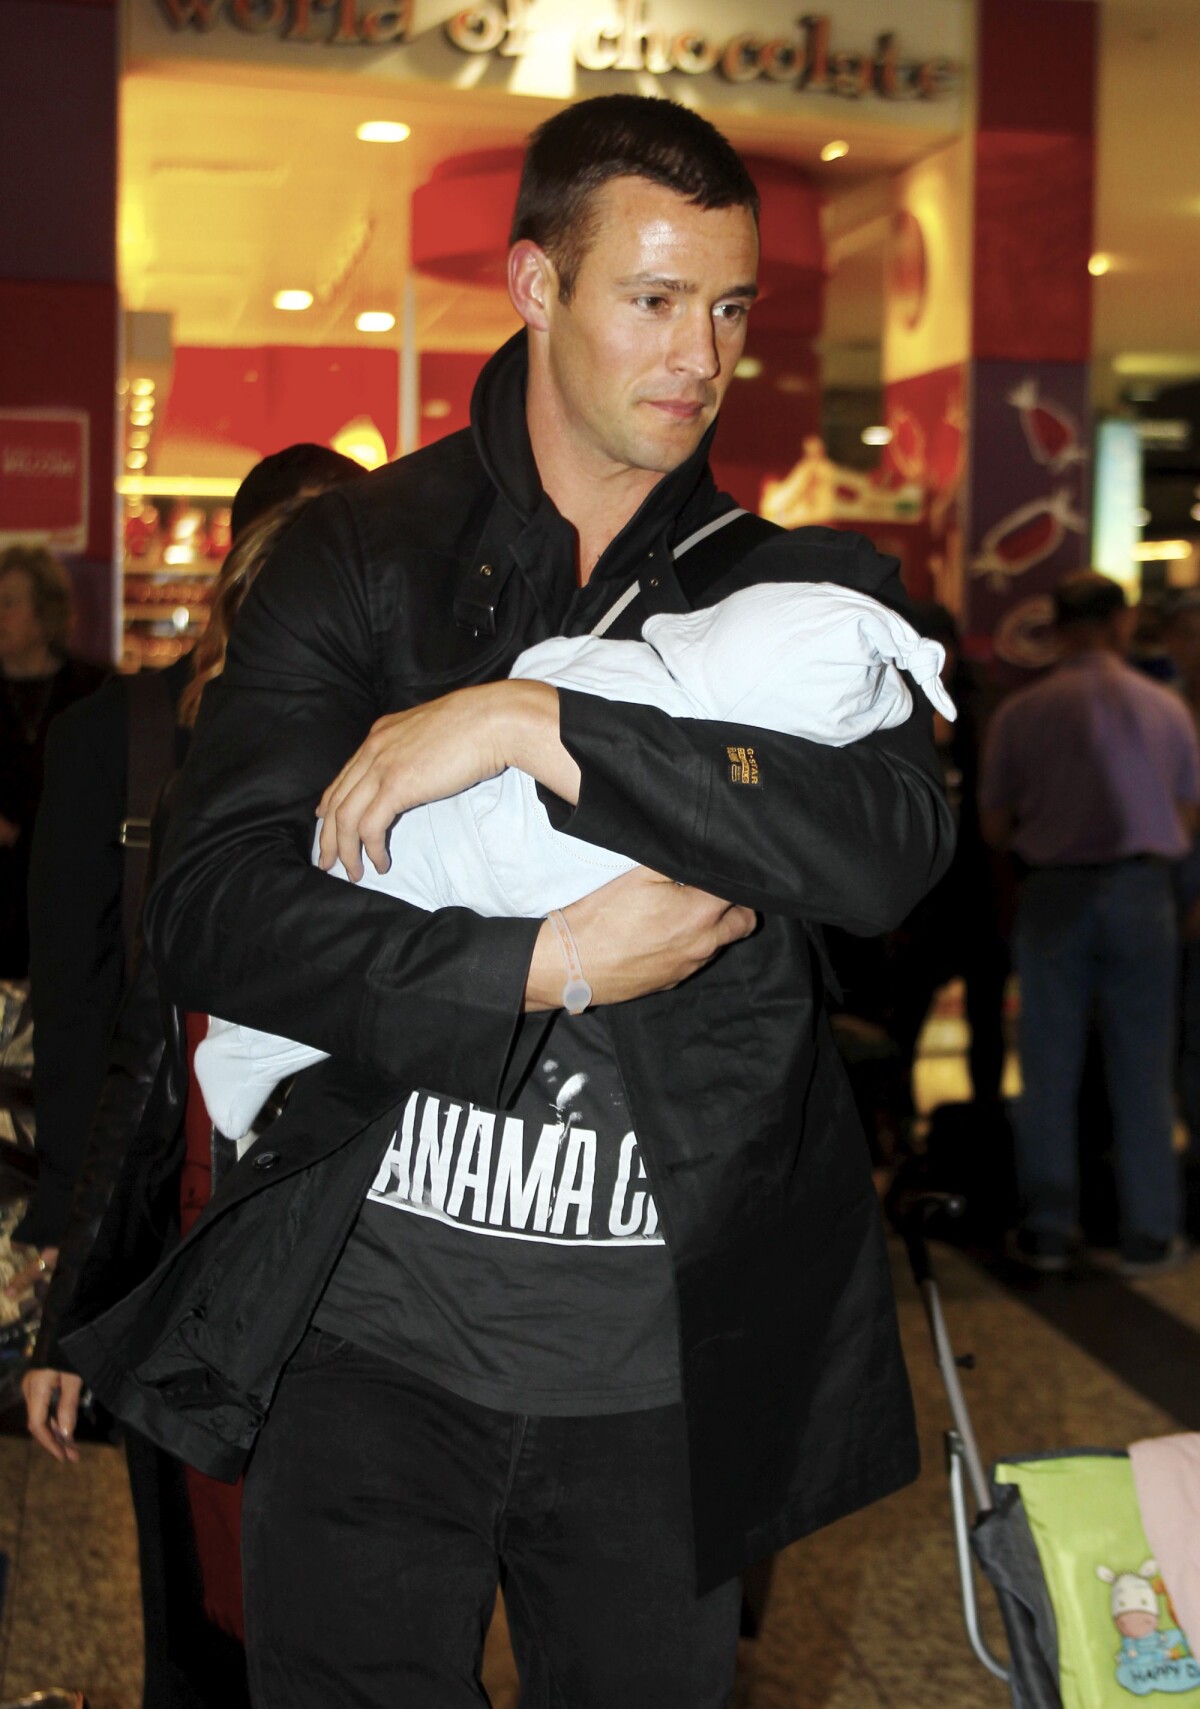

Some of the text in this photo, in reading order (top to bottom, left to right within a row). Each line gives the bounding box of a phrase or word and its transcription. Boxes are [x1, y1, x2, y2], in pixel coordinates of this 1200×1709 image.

[574, 0, 963, 99] chocolate
[746, 748, 759, 784] G-STAR
[608, 1130, 660, 1237] C
[1129, 1663, 1180, 1683] HAPPY
